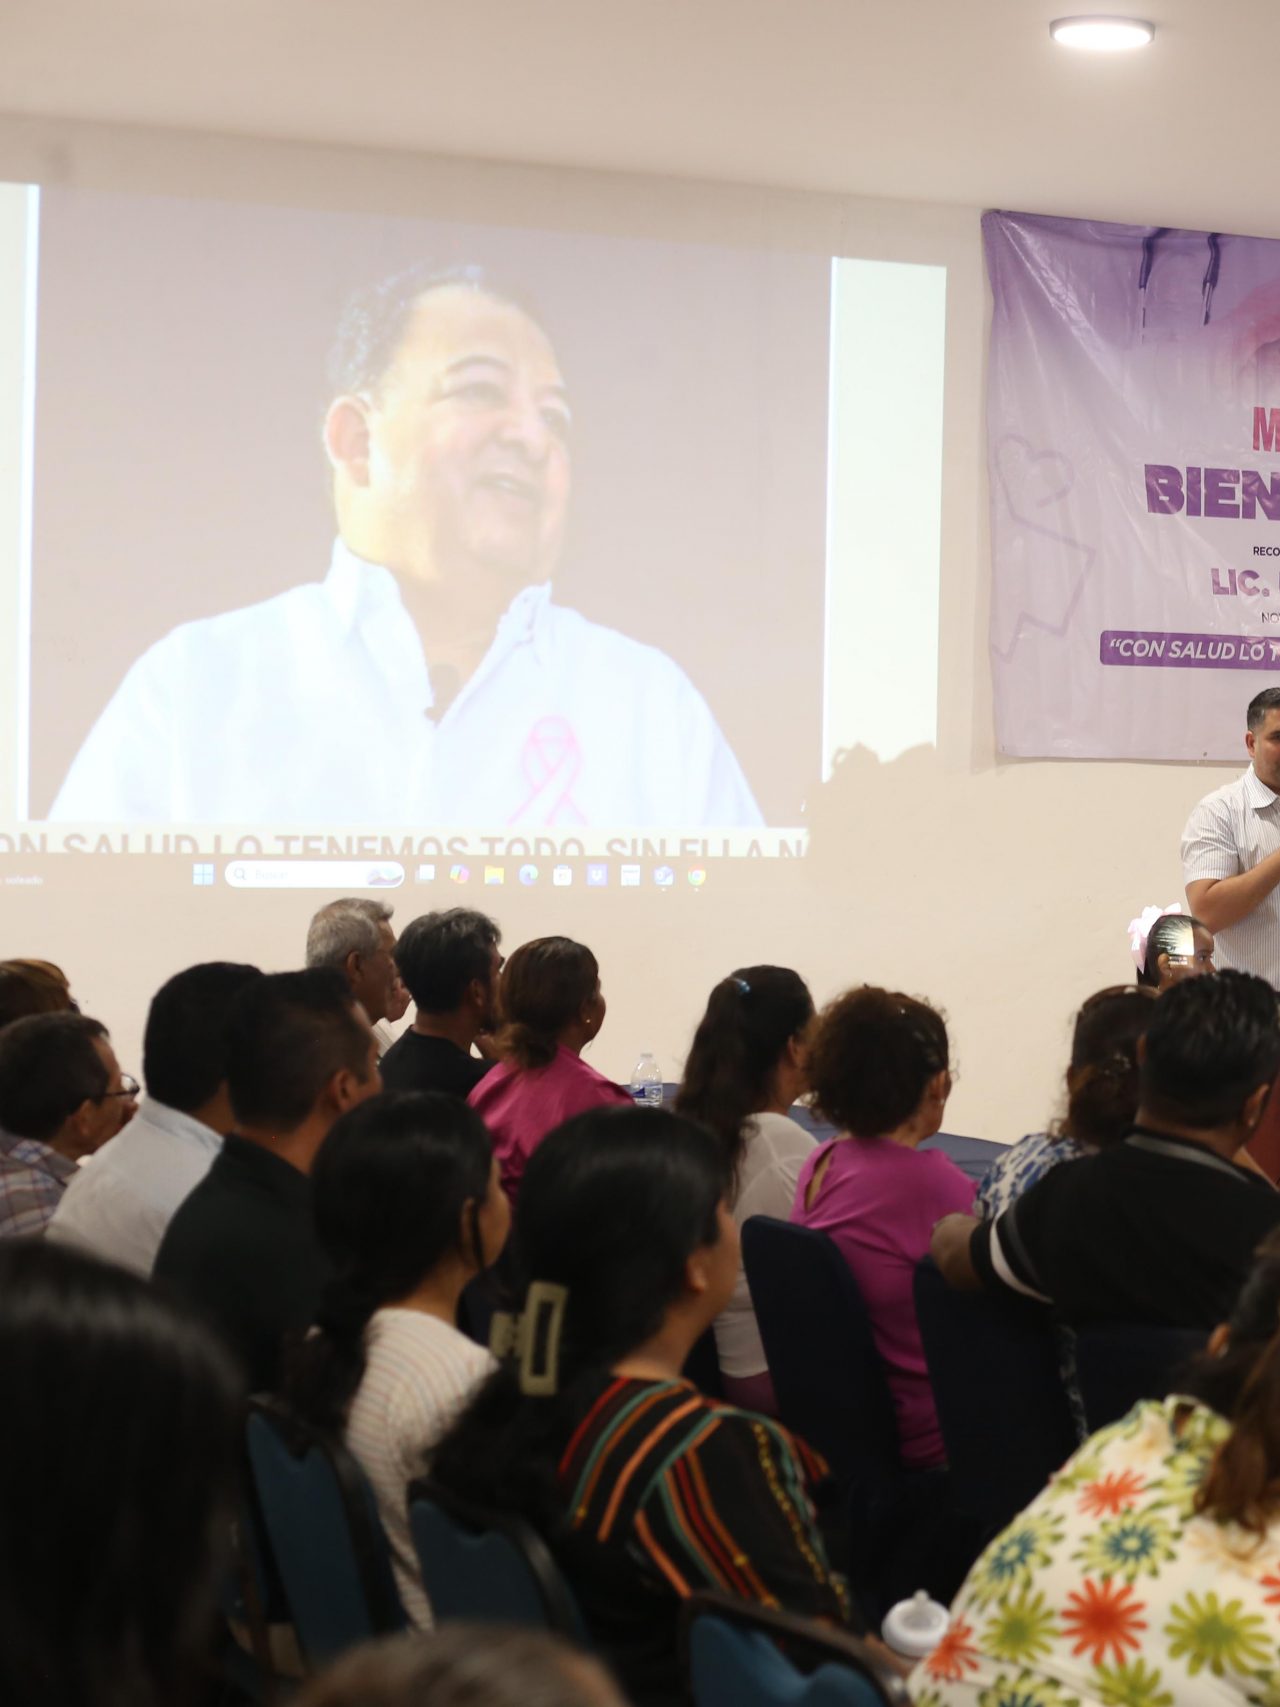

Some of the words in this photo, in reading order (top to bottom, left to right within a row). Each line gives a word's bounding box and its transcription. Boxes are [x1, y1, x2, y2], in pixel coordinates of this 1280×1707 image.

[1211, 567, 1270, 598] LIC.
[1168, 640, 1236, 660] SALUD
[1239, 643, 1265, 661] LO
